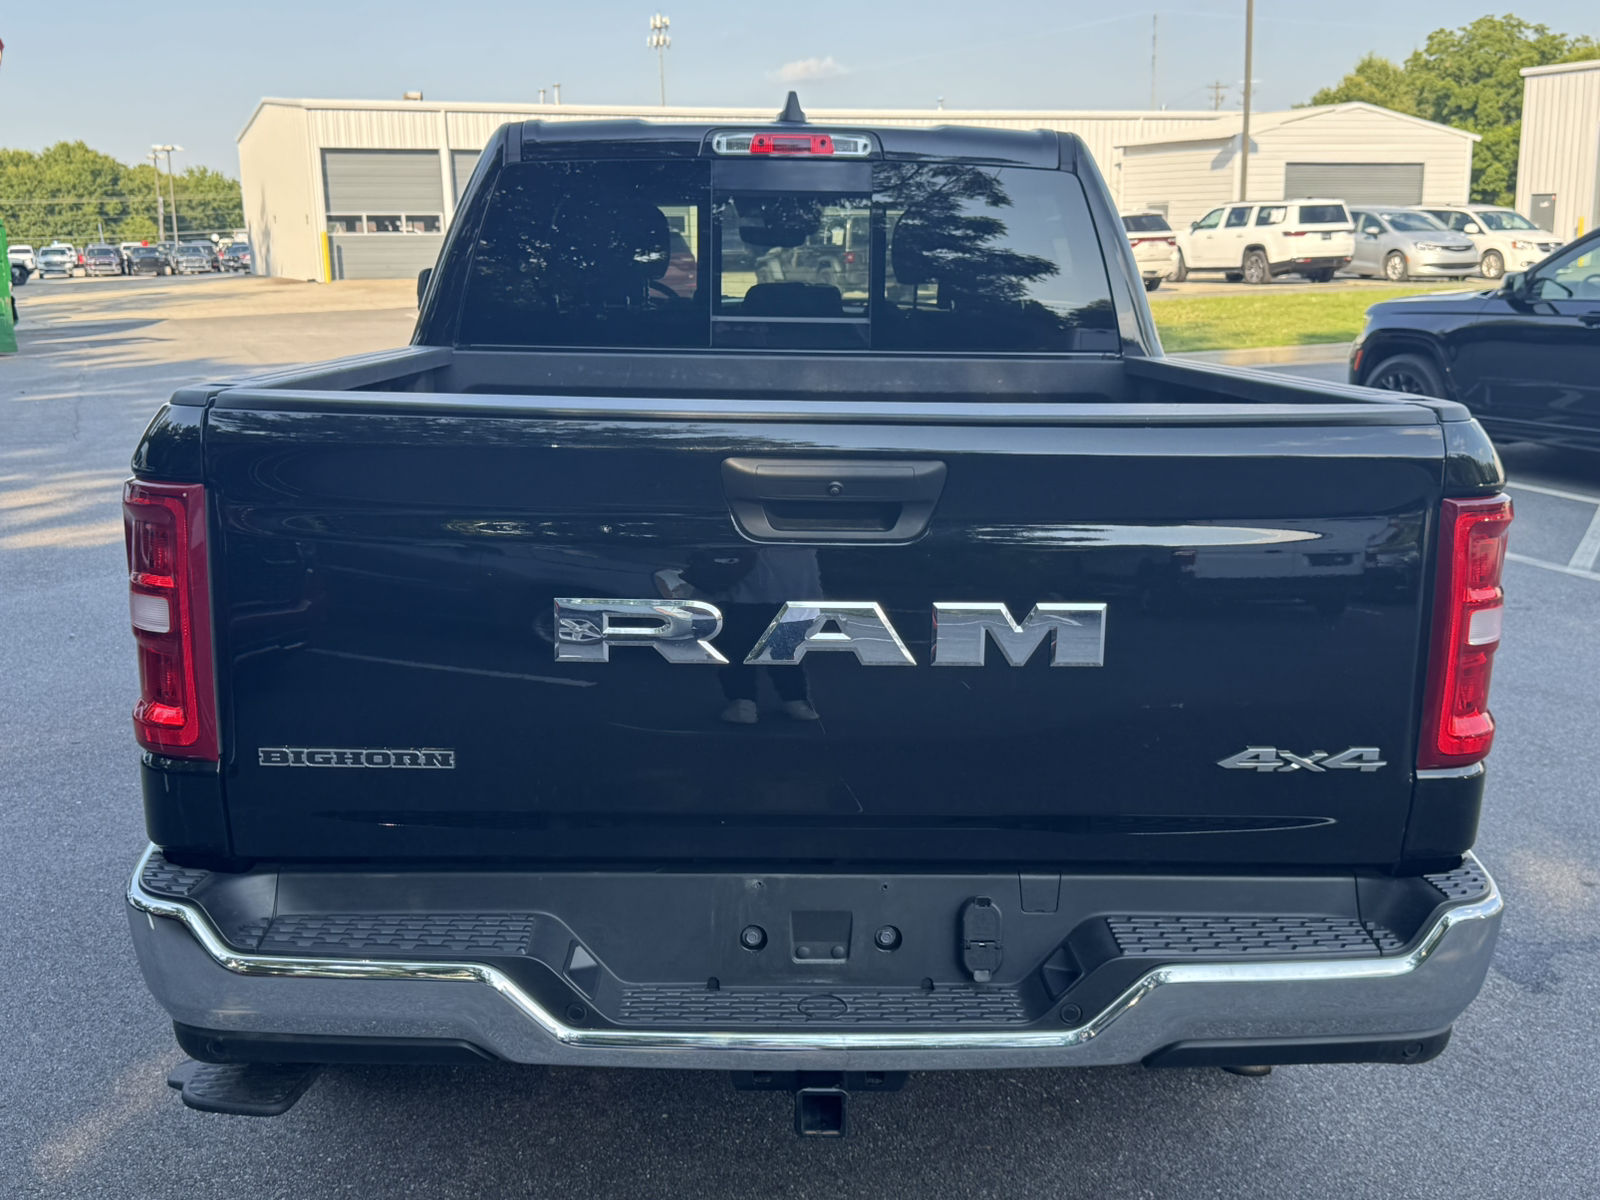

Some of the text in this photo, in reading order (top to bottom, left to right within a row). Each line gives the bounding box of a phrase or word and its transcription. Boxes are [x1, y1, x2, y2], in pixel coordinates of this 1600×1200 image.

[554, 598, 1107, 667] RAM
[258, 746, 456, 769] BIGHORN
[1217, 746, 1387, 772] 4x4
